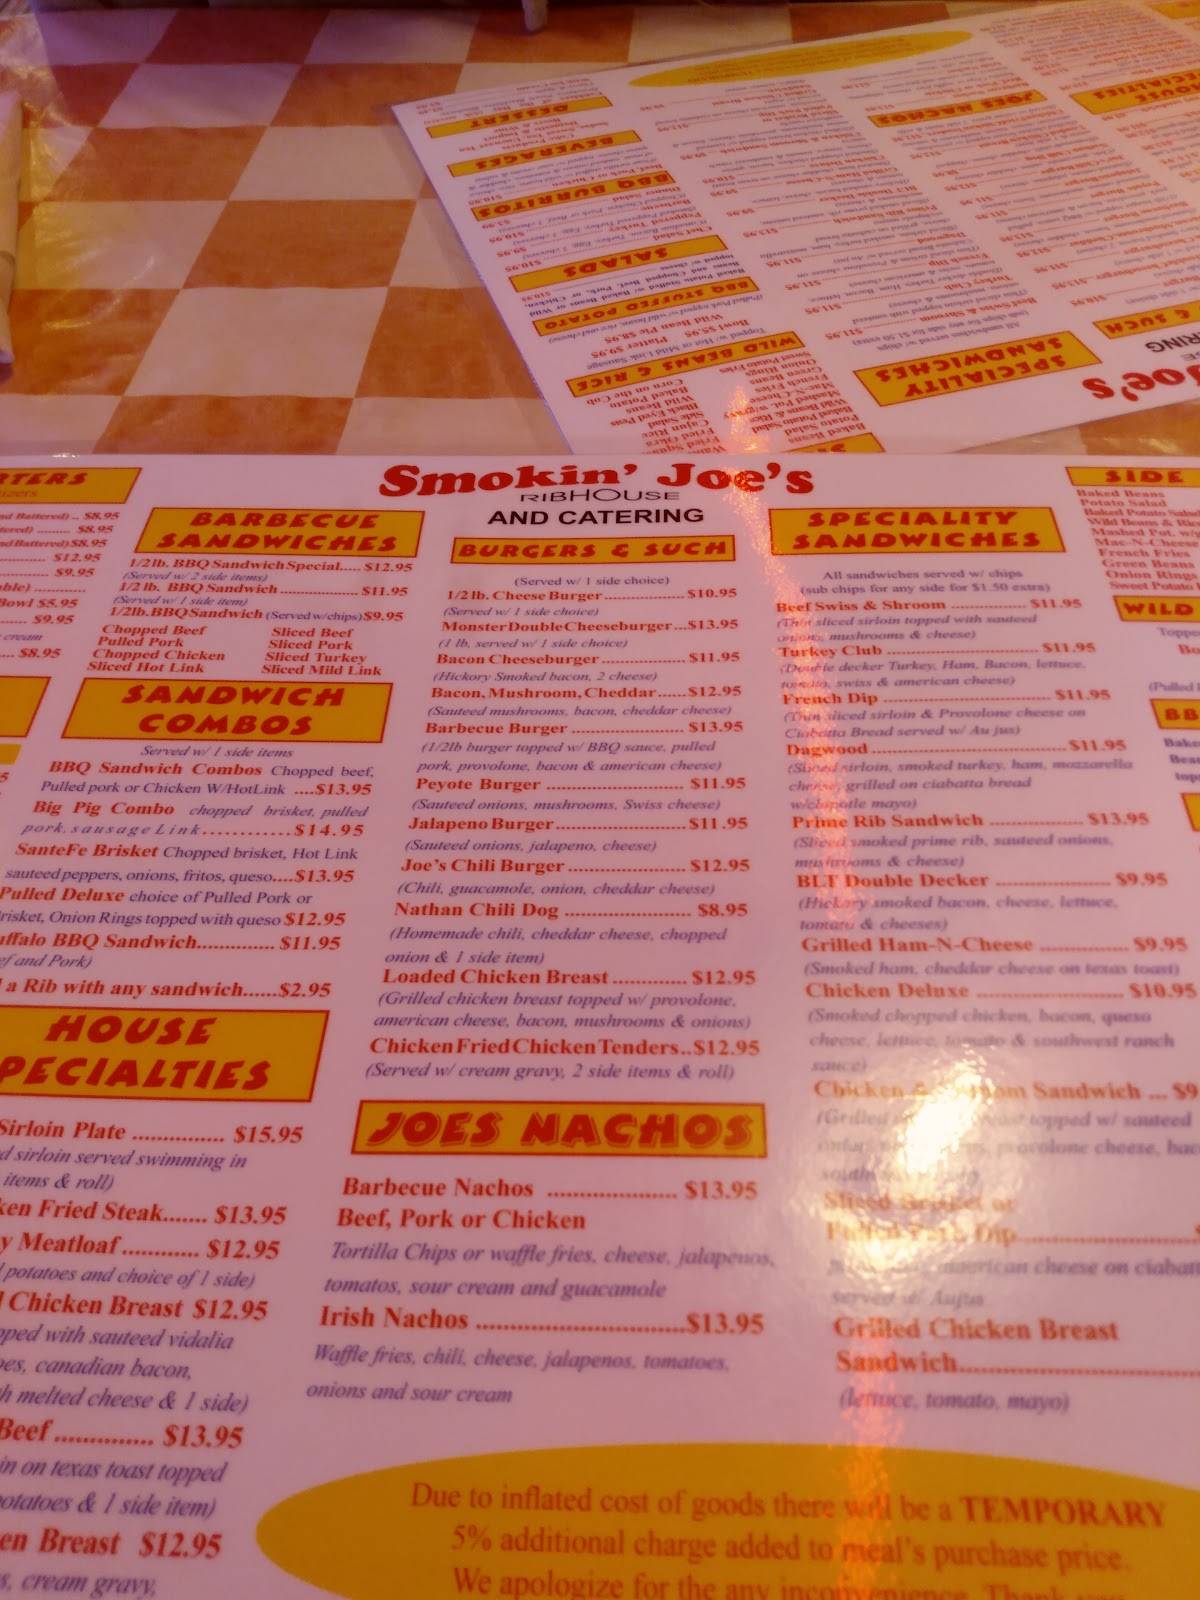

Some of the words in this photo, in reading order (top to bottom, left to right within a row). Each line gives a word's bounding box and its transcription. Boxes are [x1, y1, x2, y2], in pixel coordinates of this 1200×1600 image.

[562, 248, 667, 277] SALADS
[874, 337, 1063, 382] SANDWICHES
[904, 354, 1066, 396] SPECIALITY
[379, 463, 637, 497] Smokin'
[656, 461, 814, 494] Joe's
[1106, 470, 1183, 483] SIDE
[520, 488, 680, 503] RIBHOUSE
[84, 512, 120, 520] $8.95
[189, 512, 380, 528] BARBECUE
[488, 510, 549, 525] AND
[568, 508, 704, 524] CATERING
[808, 511, 1019, 527] SPECIALITY
[157, 533, 397, 552] SANDWICHES
[459, 544, 597, 558] BURGERS
[612, 543, 629, 557] &
[644, 541, 726, 556] SUCH
[793, 532, 1041, 550] SANDWICHES
[53, 554, 101, 562] $12.95
[823, 570, 843, 580] All
[847, 569, 917, 579] sandwiches
[921, 569, 964, 579] served
[968, 569, 985, 579] w/
[989, 569, 1023, 581] chips
[1123, 603, 1194, 615] WILD
[102, 625, 167, 637] Chopped
[173, 626, 208, 636] Beef
[272, 627, 314, 638] Sliced
[318, 628, 354, 638] Beef
[436, 654, 487, 665] Bacon
[491, 653, 599, 667] Cheeseburger
[689, 652, 740, 663] $11.95
[261, 665, 306, 675] Sliced
[309, 666, 347, 676] Mild
[349, 666, 382, 676] Link
[121, 685, 345, 706] SANDWICH
[782, 693, 841, 705] French
[844, 693, 879, 707] Dip
[1055, 689, 1111, 700] $11.95
[138, 714, 314, 736] COMBOS
[425, 723, 504, 734] Barbecue
[509, 722, 568, 736] Burger
[689, 721, 743, 733] $13.95
[48, 761, 91, 775] BBQ
[98, 762, 182, 775] Sandwich
[191, 763, 263, 776] Combos
[271, 765, 334, 779] Chopped
[340, 766, 374, 778] beef,
[14, 844, 90, 858] SanteFe
[93, 845, 159, 858] Brisket
[162, 846, 231, 861] Chopped
[233, 848, 287, 861] brisket,
[292, 848, 321, 860] Hot
[324, 849, 358, 860] Link
[401, 859, 447, 873] Joe's
[451, 859, 495, 872] Chili
[500, 859, 565, 874] Burger
[690, 859, 751, 872] $12.95
[397, 881, 444, 895] (Chili,
[449, 883, 533, 897] guacamole,
[541, 883, 587, 896] onion,
[593, 882, 655, 894] cheddar
[660, 882, 715, 895] cheese)
[394, 902, 463, 917] Nathan
[469, 902, 515, 916] Chili
[522, 903, 559, 920] Dog
[698, 902, 748, 917] $8.95
[801, 938, 873, 953] Grilled
[879, 937, 1034, 953] Ham-N-Cheese
[1133, 937, 1188, 952] $9.95
[45, 1015, 217, 1046] HOUSE
[73, 1122, 127, 1140] Plate
[233, 1126, 304, 1143] $15.95
[366, 1111, 502, 1147] JOES
[520, 1112, 754, 1148] NACHOS
[342, 1176, 446, 1197] Barbecue
[454, 1178, 534, 1198] Nachos
[684, 1181, 758, 1199] $13.95
[337, 1208, 393, 1230] Beef,
[400, 1209, 453, 1229] Pork
[461, 1213, 486, 1229] or
[493, 1209, 587, 1230] Chicken
[9, 1292, 102, 1314] Chicken
[109, 1295, 183, 1317] Breast
[192, 1300, 268, 1321] $12.95
[319, 1306, 375, 1328] Irish
[384, 1308, 469, 1330] Nachos
[834, 1317, 920, 1338] Grilled
[928, 1318, 1032, 1340] Chicken
[1039, 1319, 1119, 1341] Breast
[17, 1388, 83, 1407] melted
[87, 1390, 153, 1409] cheese
[158, 1392, 177, 1410] &
[184, 1392, 195, 1410] 1
[200, 1393, 248, 1413] side)
[411, 1482, 462, 1508] Due
[471, 1487, 493, 1507] to
[501, 1485, 592, 1512] inflated
[600, 1492, 649, 1513] cost
[658, 1490, 688, 1513] of
[691, 1491, 765, 1521] goods
[774, 1492, 835, 1520] there
[901, 1495, 930, 1521] be
[938, 1504, 953, 1521] a
[960, 1496, 1165, 1527] TEMPORARY
[452, 1525, 492, 1552] 5%
[500, 1527, 625, 1555] additional
[634, 1530, 716, 1564] charge
[725, 1532, 800, 1560] added
[809, 1537, 833, 1561] to
[934, 1539, 1047, 1572] purchase
[1057, 1543, 1132, 1575] price.
